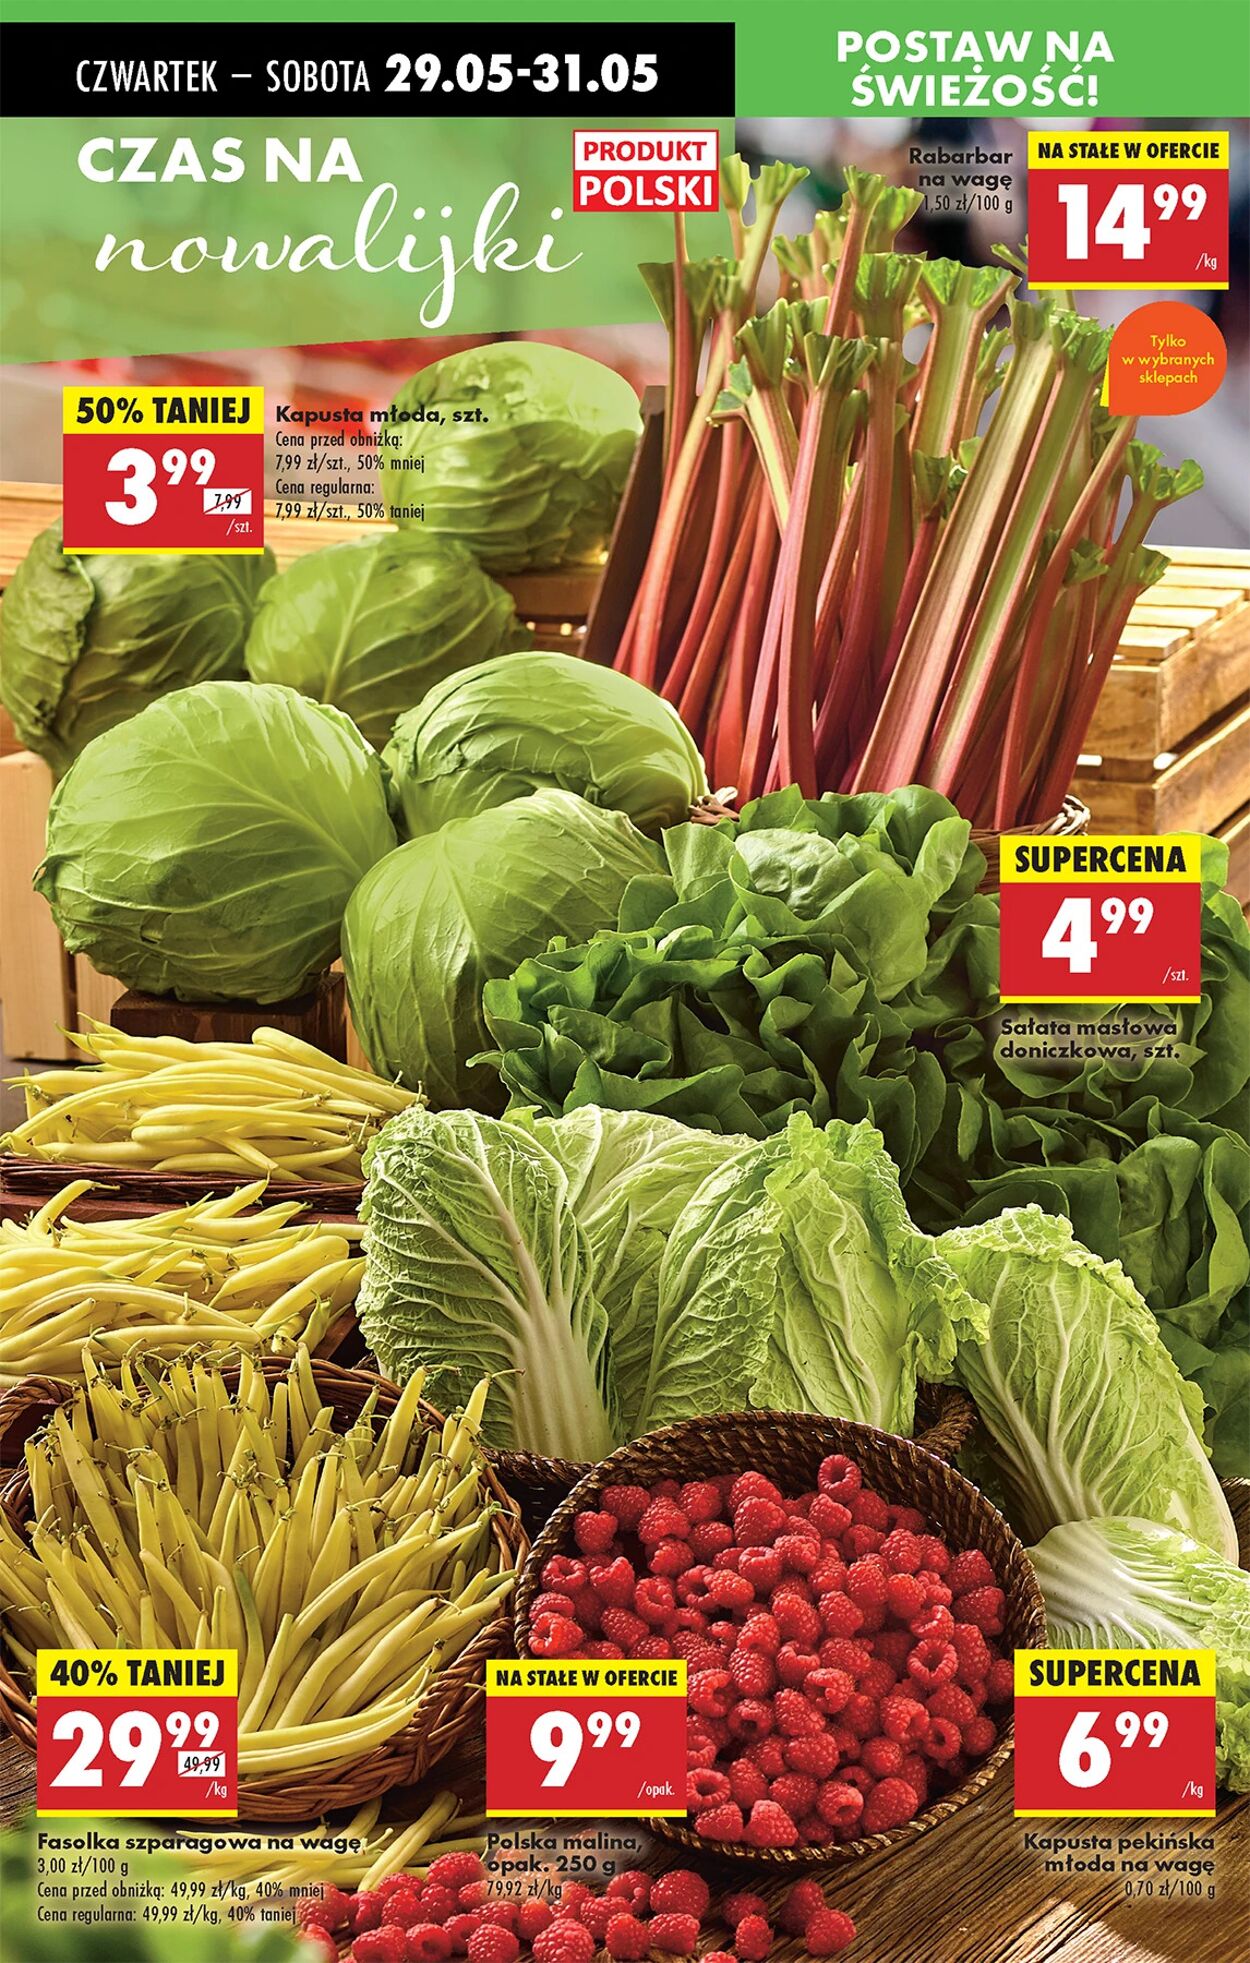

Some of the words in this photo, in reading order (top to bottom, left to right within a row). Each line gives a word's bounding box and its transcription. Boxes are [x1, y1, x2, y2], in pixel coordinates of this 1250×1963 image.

[837, 30, 1032, 63] POSTAW
[1046, 30, 1115, 63] NA
[76, 60, 218, 93] CZWARTEK
[267, 60, 370, 93] SOBOTA
[384, 53, 659, 93] 29.05-31.05
[850, 64, 1100, 107] ŚWIEŻOŚĆ!
[77, 137, 244, 183] CZAS
[266, 137, 364, 183] NA
[584, 141, 707, 162] PRODUKT
[909, 146, 1013, 165] Rabarbar
[1038, 143, 1065, 159] NA
[1068, 143, 1120, 159] STAŁE
[1122, 143, 1141, 159] W
[1146, 143, 1220, 159] OFERCIE
[579, 176, 713, 206] POLSKI
[919, 172, 946, 187] na
[951, 172, 1012, 191] wagę
[924, 195, 950, 213] 1,50
[956, 193, 999, 213] zł/100
[1004, 198, 1013, 214] g
[94, 182, 584, 329] nowalijki
[1195, 253, 1217, 271] /kg
[1150, 335, 1186, 350] Tylko
[1122, 354, 1134, 366] w
[1138, 353, 1215, 369] wybranych
[1139, 370, 1198, 386] sklepach
[76, 397, 143, 424] 50%
[152, 397, 250, 424] TANIEJ
[276, 405, 363, 425] Kapusta
[370, 404, 446, 425] młoda,
[452, 406, 489, 423] szt.
[276, 432, 306, 448] Cena
[310, 431, 345, 451] przed
[350, 431, 403, 452] obniżką:
[276, 454, 301, 473] 7,99
[306, 454, 351, 473] zł/szt.,
[357, 454, 385, 471] 50%
[390, 454, 425, 474] mniej
[276, 479, 306, 495] Cena
[310, 479, 374, 498] regularna:
[215, 493, 242, 512] 7,99
[276, 502, 301, 521] 7,99
[306, 501, 351, 521] zł/szt.,
[357, 502, 385, 519] 50%
[390, 502, 425, 522] taniej
[226, 519, 252, 536] /szt.
[1015, 845, 1186, 873] SUPERCENA
[1162, 967, 1189, 984] /szt.
[1001, 1018, 1070, 1035] Sałata
[1077, 1018, 1177, 1035] masłowa
[1000, 1041, 1137, 1061] doniczkowa,
[1144, 1043, 1180, 1059] szt.
[50, 1660, 118, 1686] 40%
[127, 1660, 225, 1687] TANIEJ
[496, 1670, 522, 1686] NA
[527, 1670, 577, 1686] STAŁE
[582, 1670, 600, 1686] W
[605, 1670, 677, 1686] OFERCIE
[1029, 1660, 1201, 1686] SUPERCENA
[183, 1757, 220, 1774] 49,99
[205, 1782, 227, 1798] /kg
[637, 1781, 675, 1799] /opak.
[1182, 1781, 1203, 1798] /kg
[37, 1833, 120, 1850] Fasolka
[125, 1836, 260, 1854] szparagowa
[268, 1836, 294, 1850] na
[299, 1836, 362, 1854] wagę
[487, 1833, 557, 1850] Polska
[563, 1833, 643, 1853] malina,
[1025, 1833, 1112, 1853] Kapusta
[1118, 1832, 1215, 1853] pekińska
[37, 1858, 66, 1876] 3,00
[71, 1858, 115, 1875] zł/100
[121, 1862, 129, 1876] g
[487, 1855, 550, 1876] opak.
[557, 1856, 597, 1872] 250
[603, 1860, 616, 1876] g
[1045, 1855, 1115, 1872] młoda
[1121, 1859, 1148, 1872] na
[1155, 1859, 1215, 1876] wagę
[37, 1883, 67, 1898] Cena
[72, 1883, 108, 1900] przed
[112, 1882, 165, 1901] obniżką:
[171, 1883, 206, 1900] 49,99
[211, 1882, 250, 1901] zł/kg,
[256, 1883, 284, 1898] 40%
[289, 1883, 325, 1901] mniej
[487, 1881, 522, 1898] 79,92
[528, 1879, 562, 1898] zł/kg
[1125, 1881, 1153, 1898] 0,70
[1159, 1880, 1202, 1897] zł/100
[1208, 1884, 1215, 1899] g
[37, 1908, 67, 1922] Cena
[72, 1907, 137, 1925] regularna:
[142, 1908, 177, 1924] 49,99
[183, 1907, 222, 1925] zł/kg,
[227, 1908, 255, 1922] 40%
[260, 1907, 296, 1925] taniej
